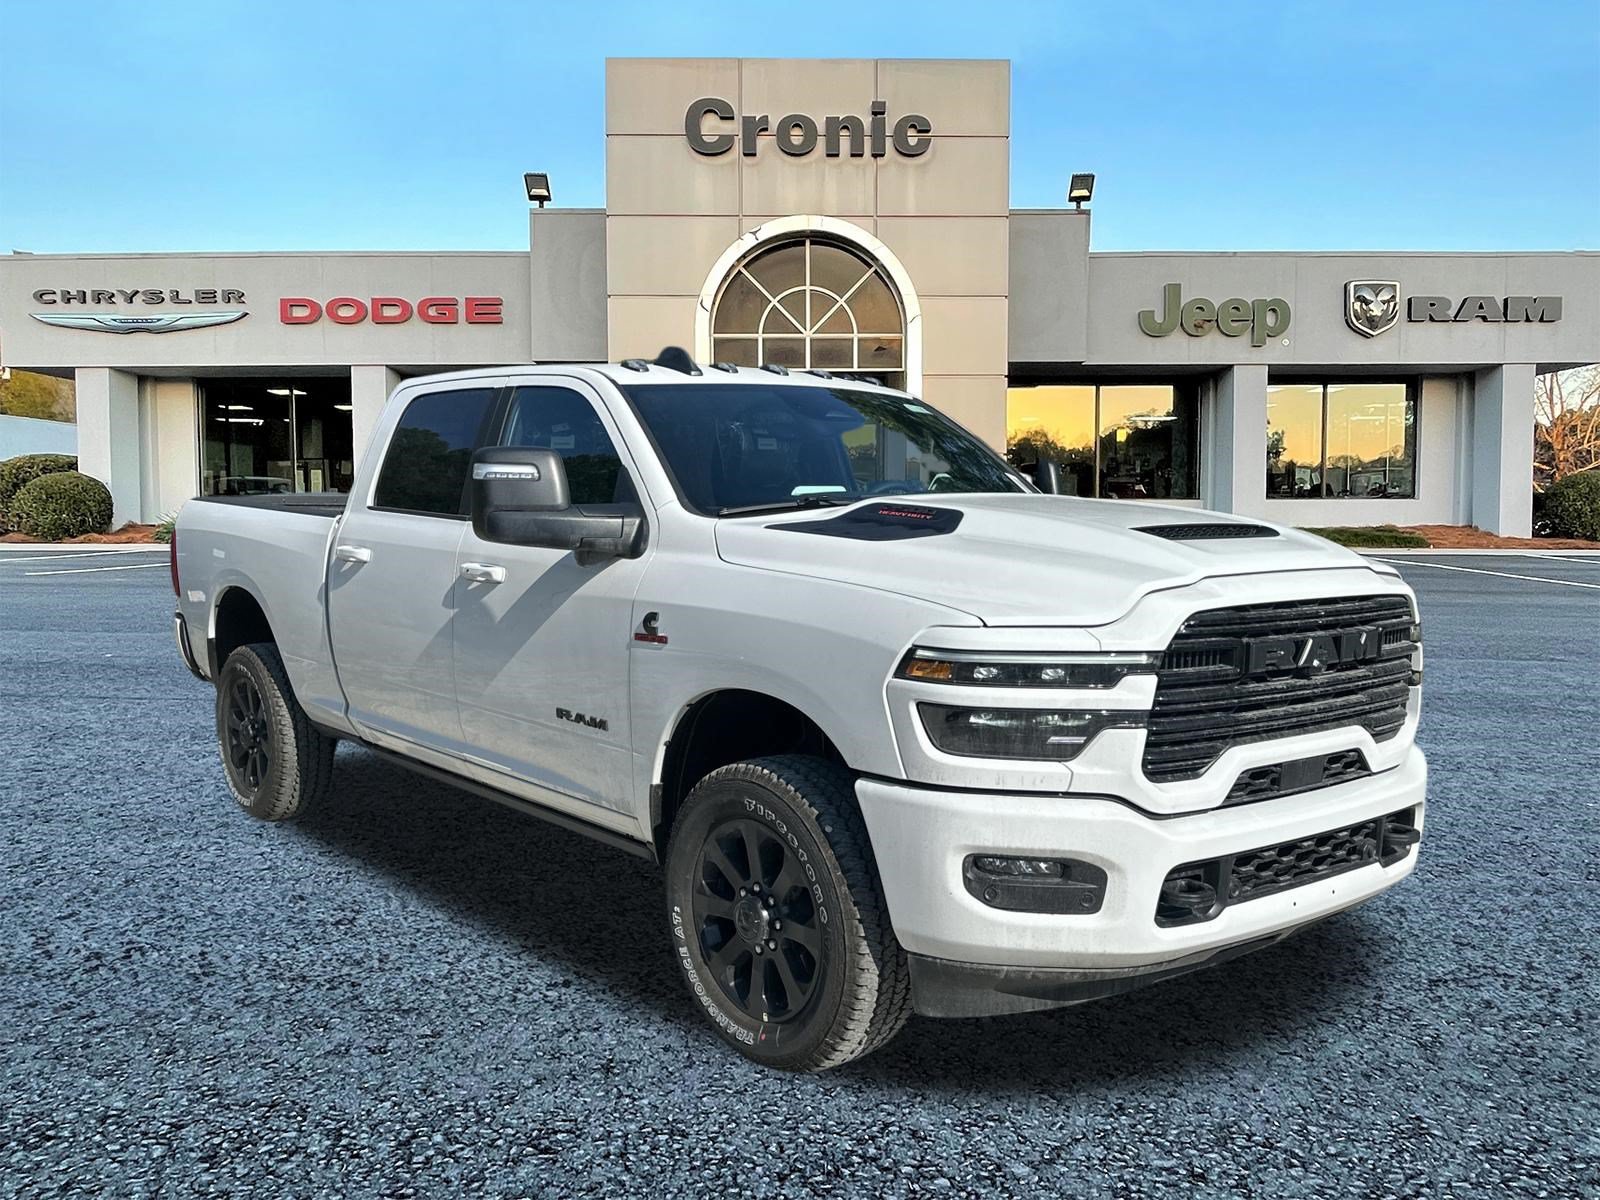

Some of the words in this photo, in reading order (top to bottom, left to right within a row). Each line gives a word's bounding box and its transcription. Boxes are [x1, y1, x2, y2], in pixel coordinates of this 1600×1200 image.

[684, 97, 932, 157] Cronic
[32, 288, 247, 305] CHRYSLER
[279, 296, 504, 325] DODGE
[1138, 283, 1291, 347] Jeep
[1406, 295, 1562, 323] RAM
[1248, 627, 1379, 672] RAM
[555, 706, 609, 732] RAM
[678, 945, 755, 1046] TRANSFORCE
